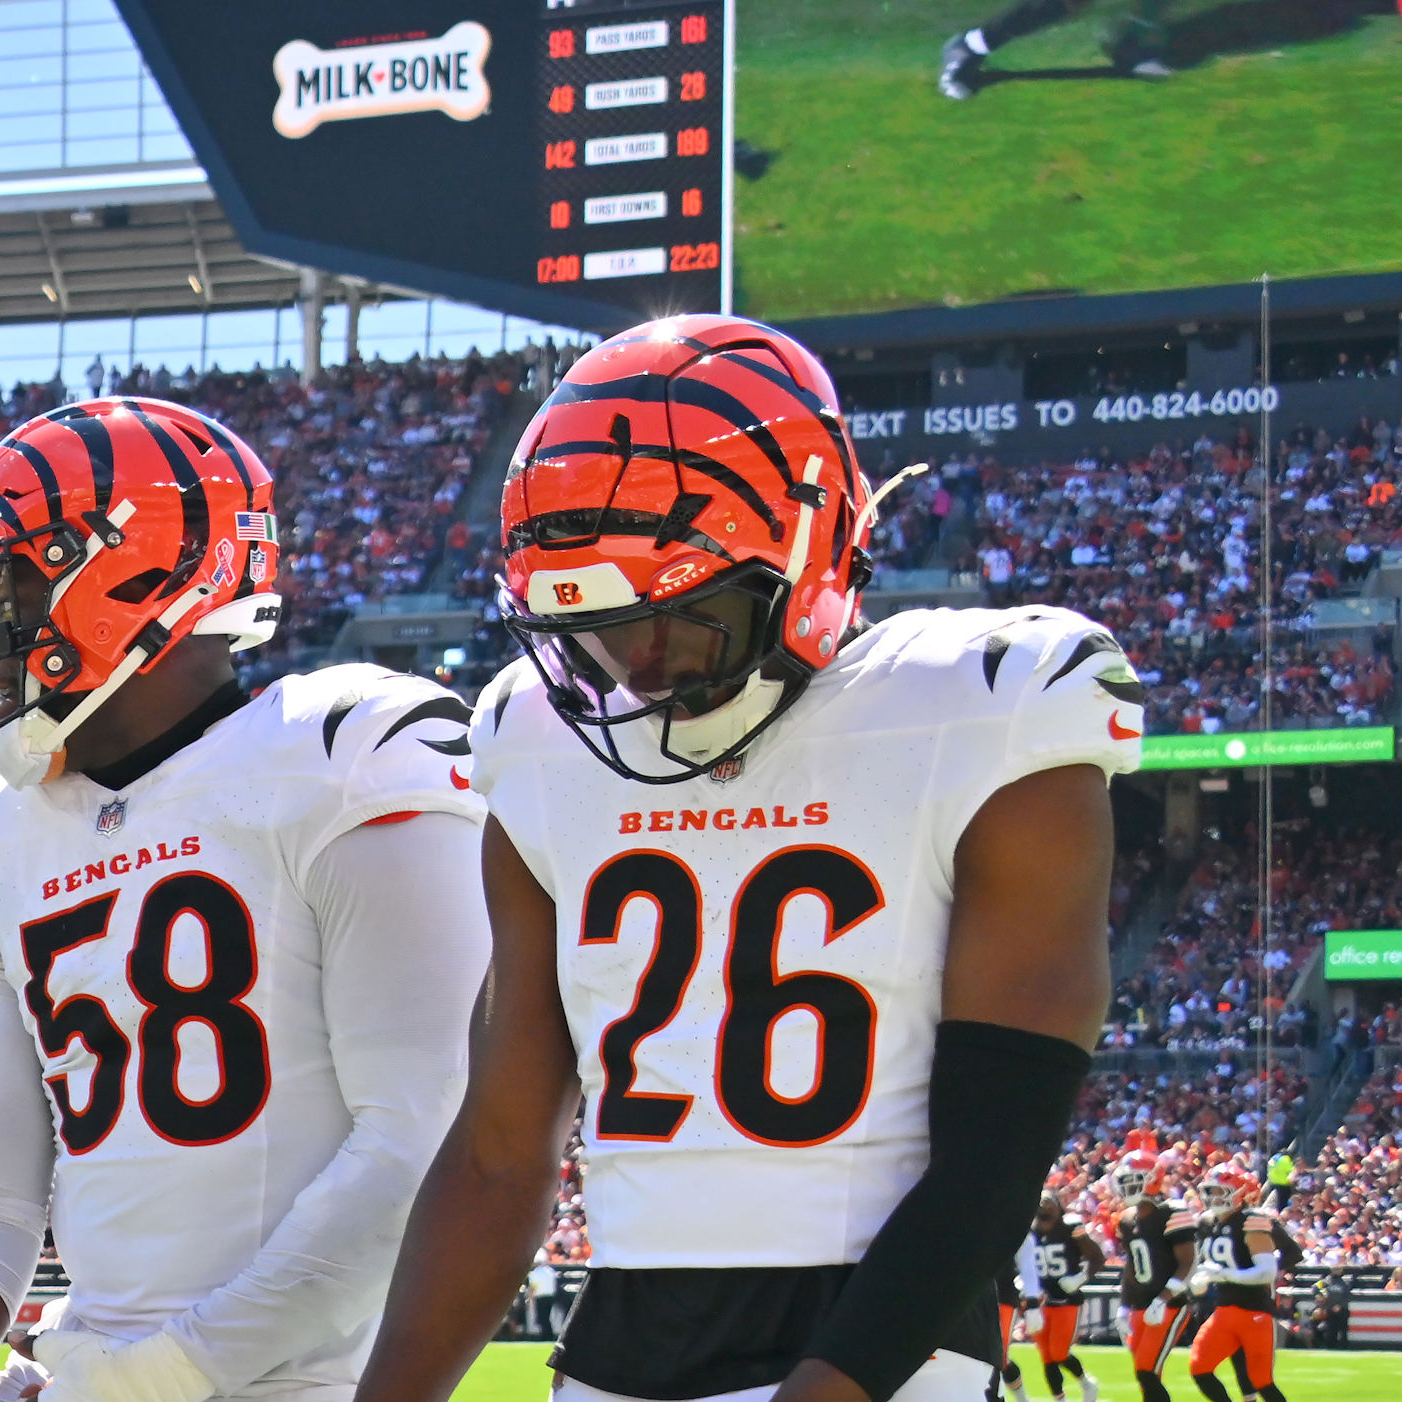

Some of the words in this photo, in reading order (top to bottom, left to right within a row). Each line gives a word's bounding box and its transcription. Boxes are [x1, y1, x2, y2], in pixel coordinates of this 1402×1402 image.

[296, 61, 374, 108] MILK
[389, 51, 469, 93] BONE
[924, 403, 1018, 433] ISSUES
[1035, 399, 1076, 427] TO
[1092, 385, 1278, 423] 440-824-6000
[654, 565, 708, 597] OAKLEY
[617, 801, 829, 835] BENGALS
[41, 835, 202, 900] BENGALS
[19, 870, 272, 1156] 58
[577, 842, 886, 1148] 26
[1129, 1239, 1153, 1284] 0
